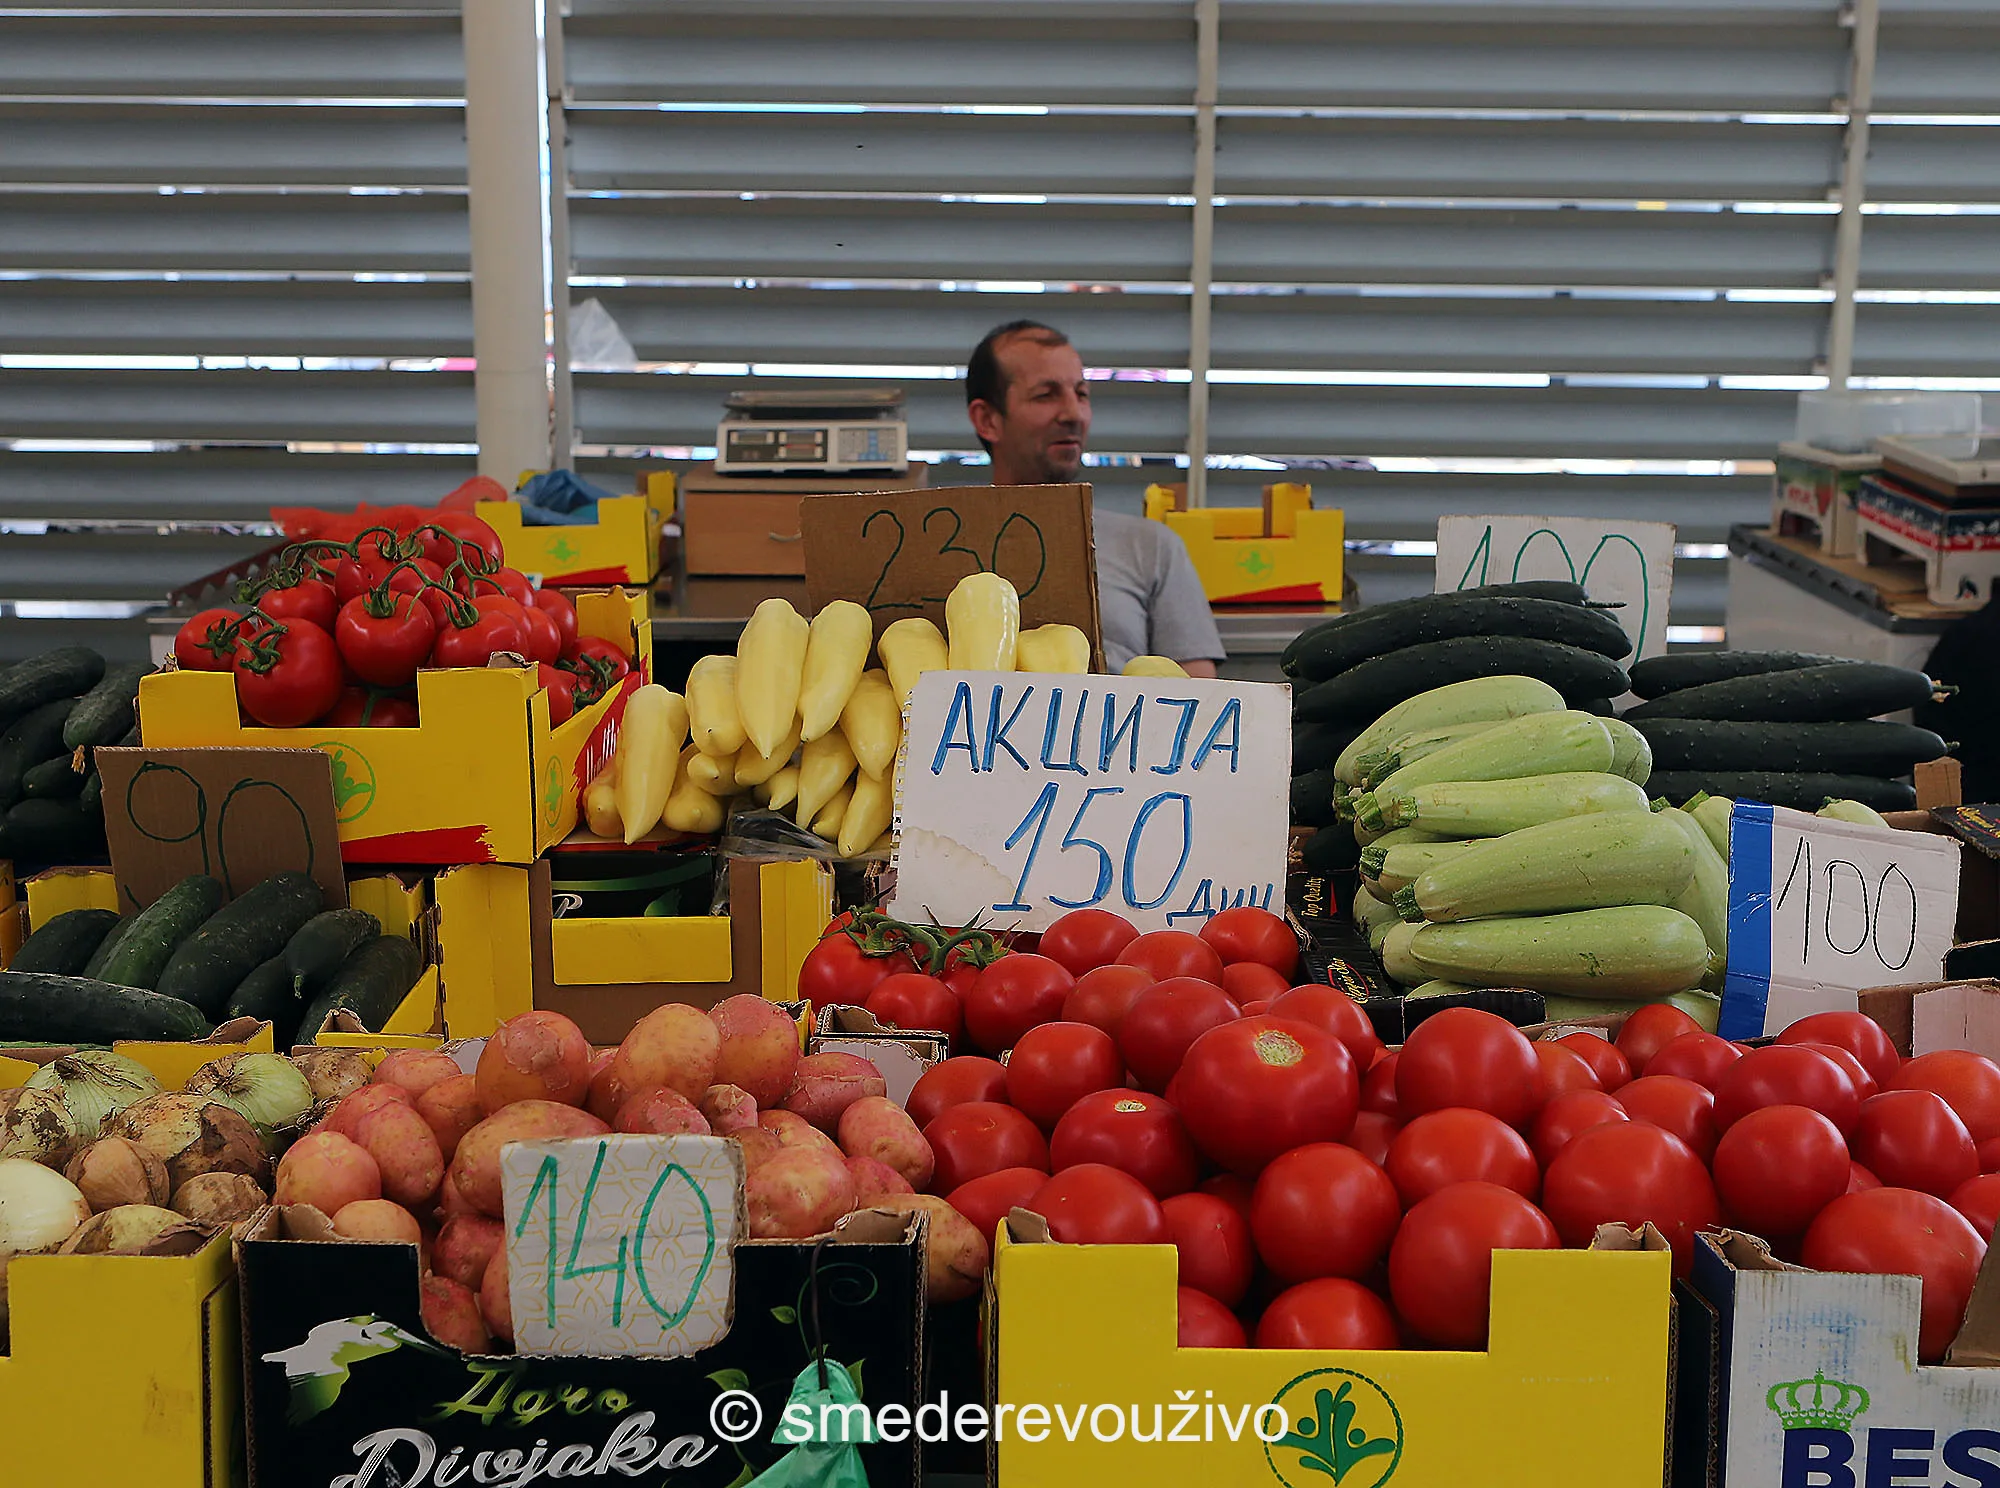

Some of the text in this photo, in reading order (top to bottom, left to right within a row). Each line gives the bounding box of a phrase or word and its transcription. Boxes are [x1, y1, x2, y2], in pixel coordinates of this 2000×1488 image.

[862, 507, 1046, 611] 230
[931, 681, 1241, 775] АКЦИЈА
[125, 761, 314, 910] 90
[992, 782, 1192, 911] 150
[1777, 836, 1918, 970] 100
[515, 1141, 715, 1330] 140
